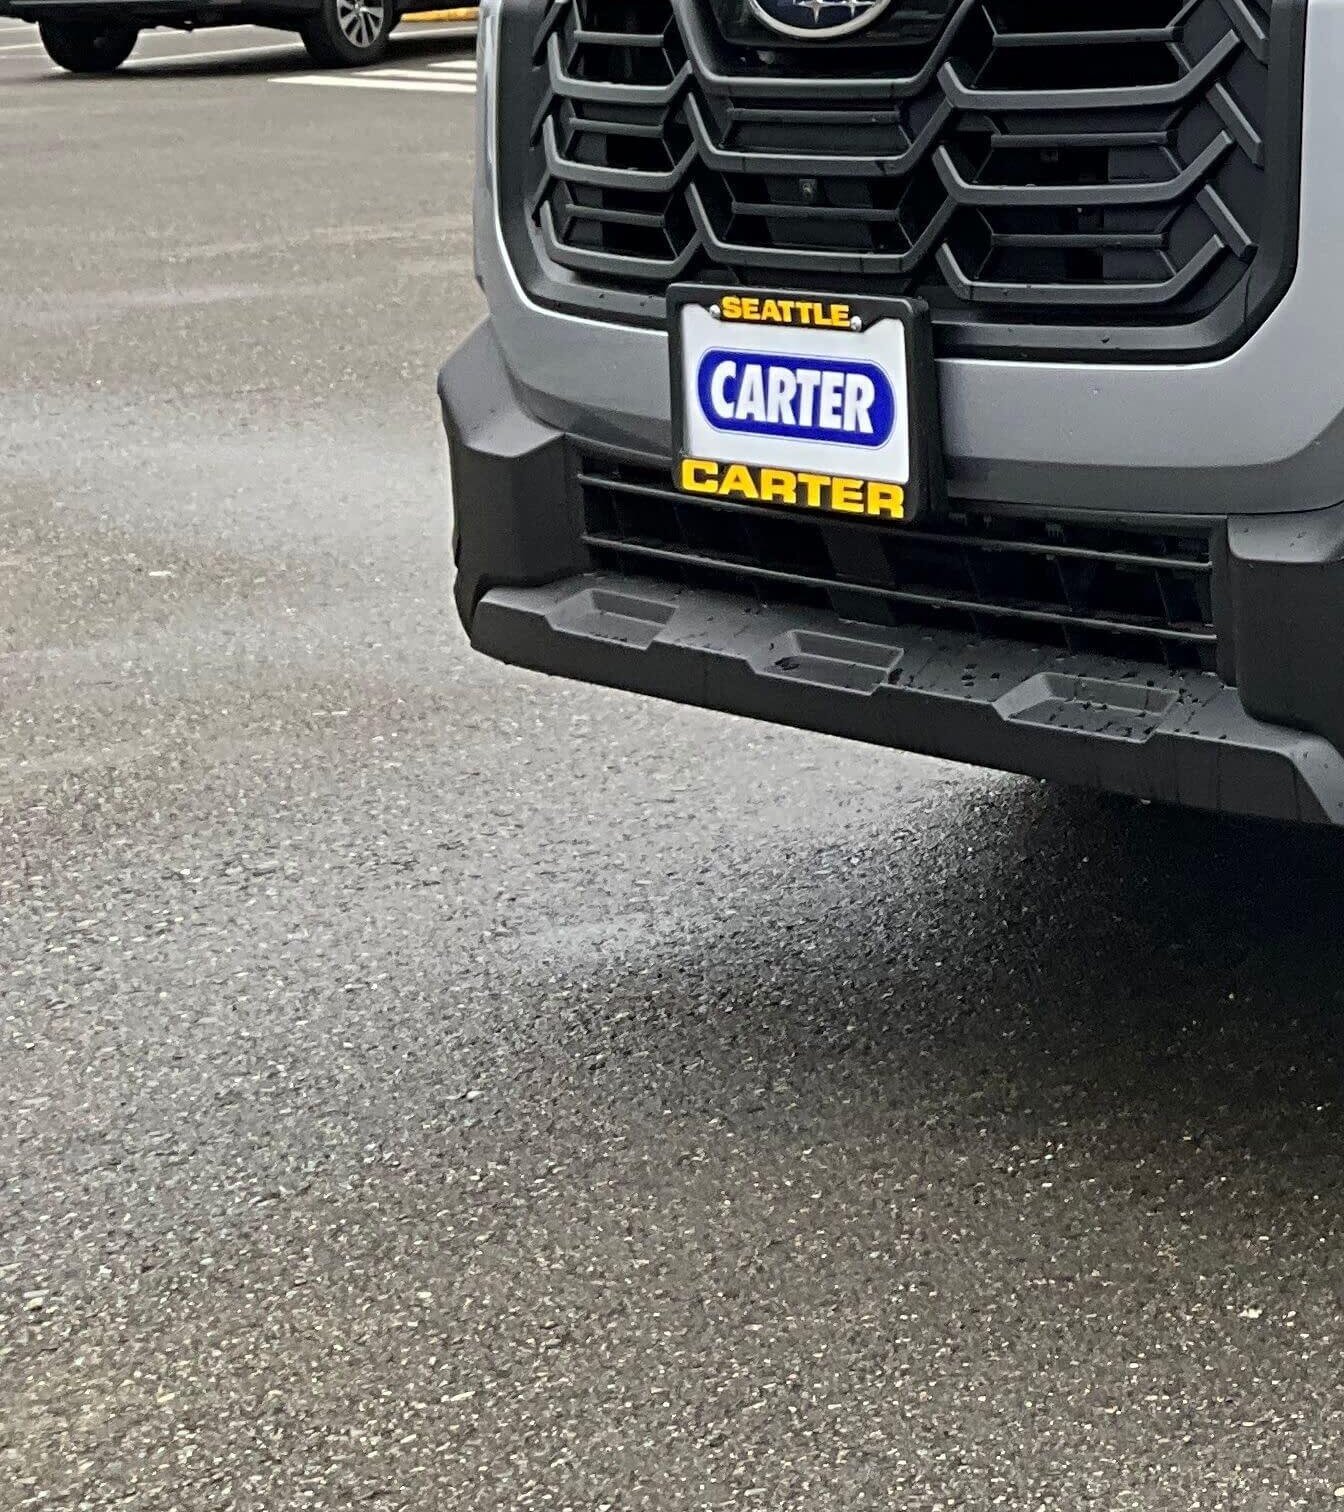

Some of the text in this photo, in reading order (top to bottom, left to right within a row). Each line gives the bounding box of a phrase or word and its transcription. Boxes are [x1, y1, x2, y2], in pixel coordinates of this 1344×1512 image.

[722, 296, 851, 328] SEATTLE
[710, 360, 876, 434] CARTER
[681, 458, 905, 519] CARTER
